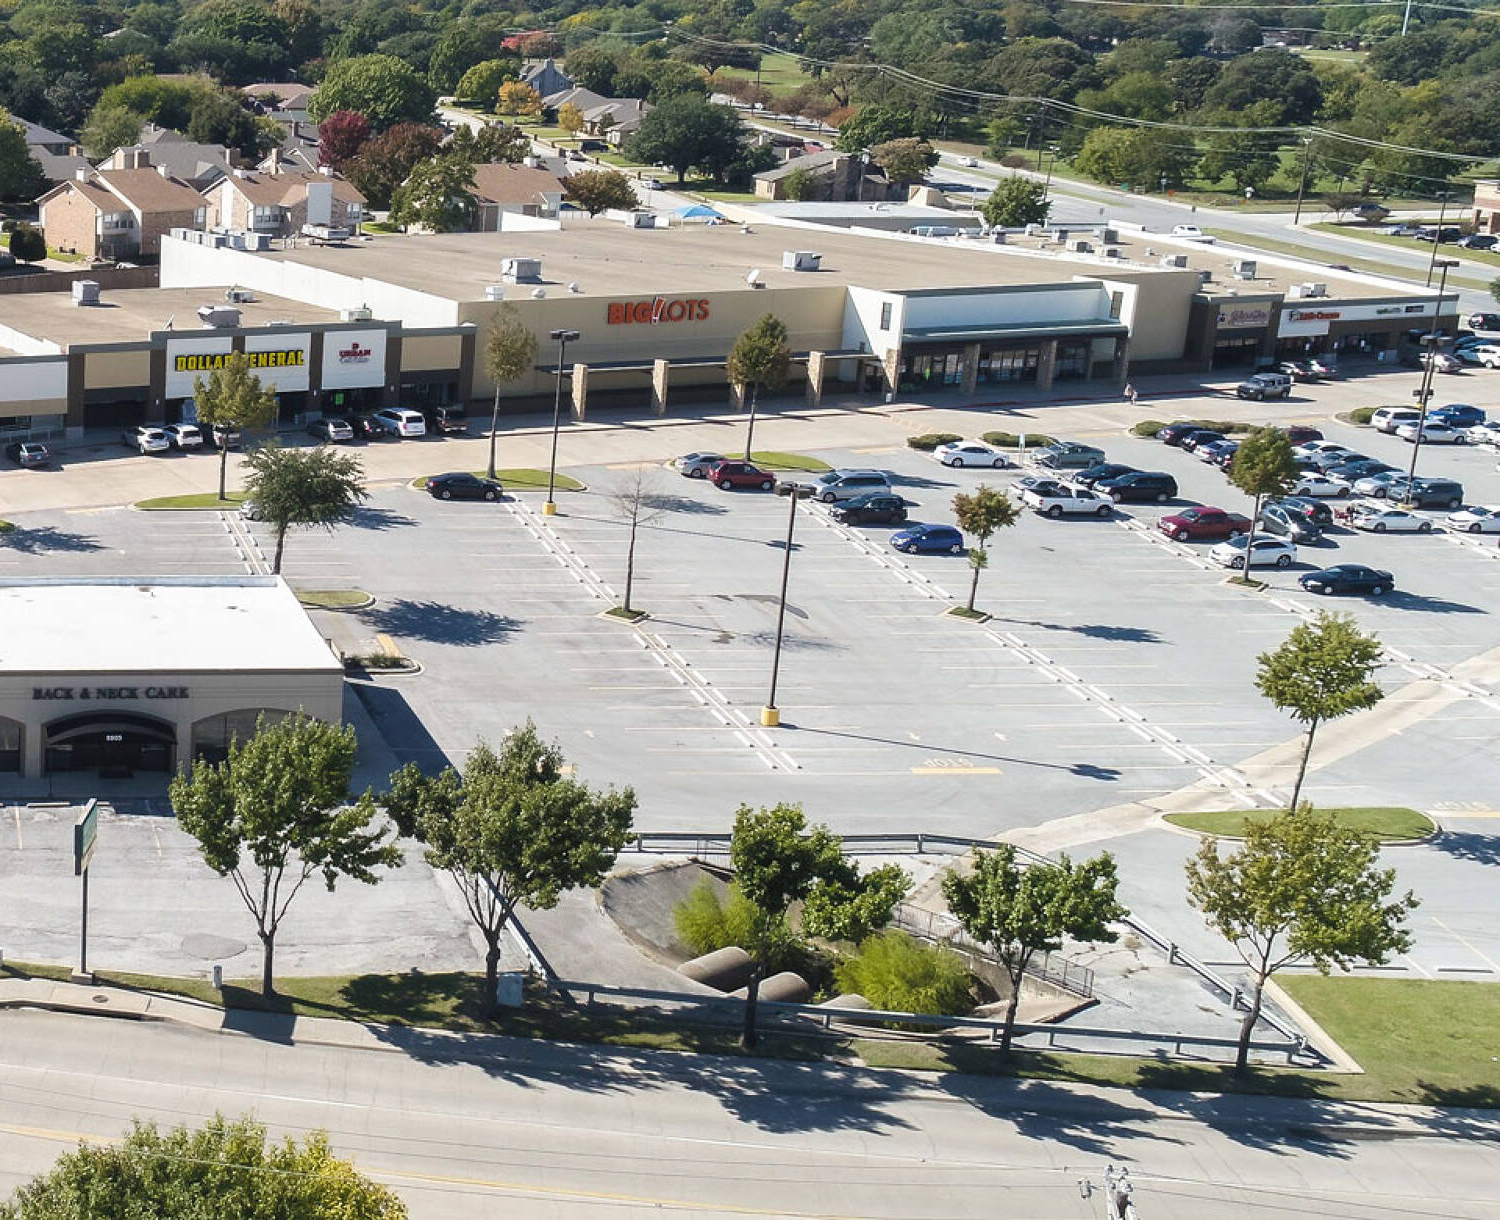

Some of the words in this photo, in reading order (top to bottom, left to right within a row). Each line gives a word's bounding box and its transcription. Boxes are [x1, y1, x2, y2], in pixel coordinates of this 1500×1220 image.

[246, 350, 305, 368] ENERAL
[33, 687, 74, 700] BACK
[96, 687, 140, 699] NECK
[145, 687, 190, 699] CARE
